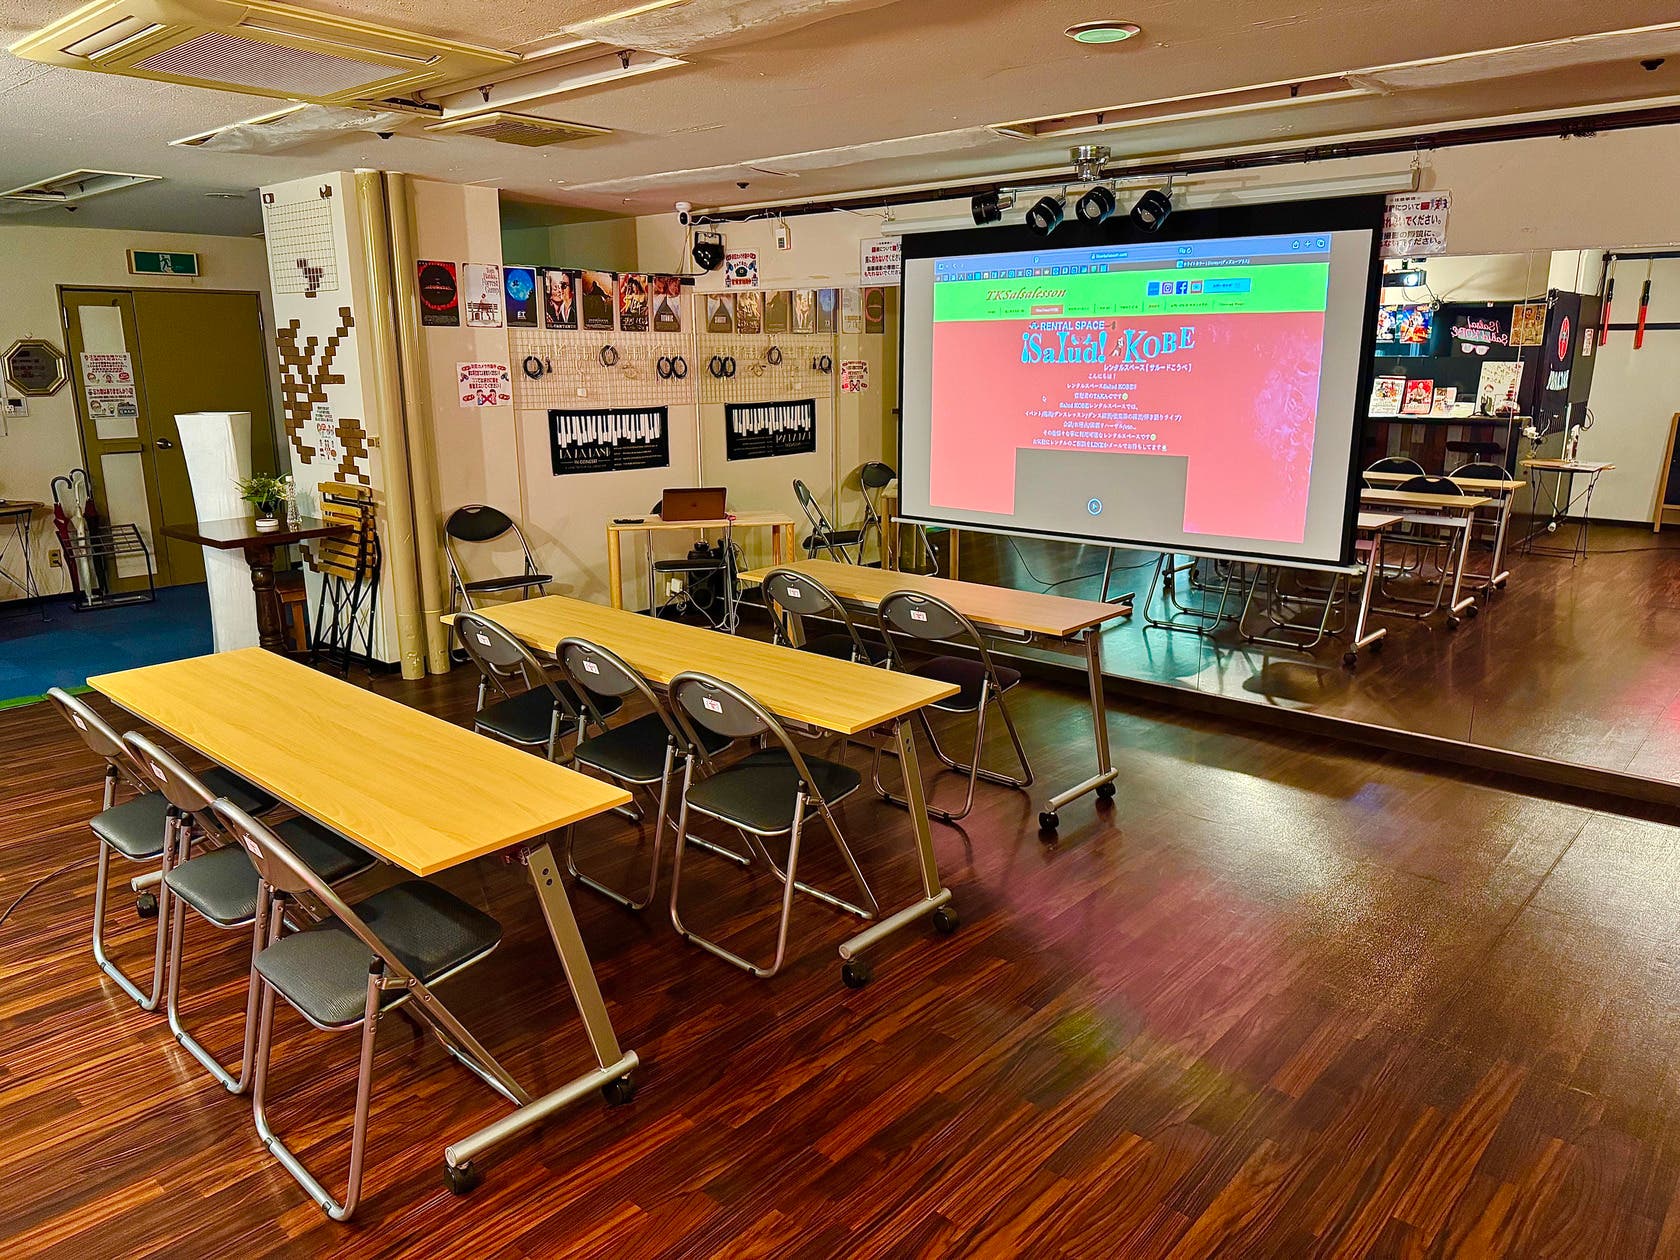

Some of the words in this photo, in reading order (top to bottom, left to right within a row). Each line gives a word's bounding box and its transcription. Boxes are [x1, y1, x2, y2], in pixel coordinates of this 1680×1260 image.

[1040, 321, 1073, 331] RENTAL
[1075, 321, 1105, 330] SPACE
[1122, 326, 1196, 363] KOBE
[588, 446, 610, 459] LAND
